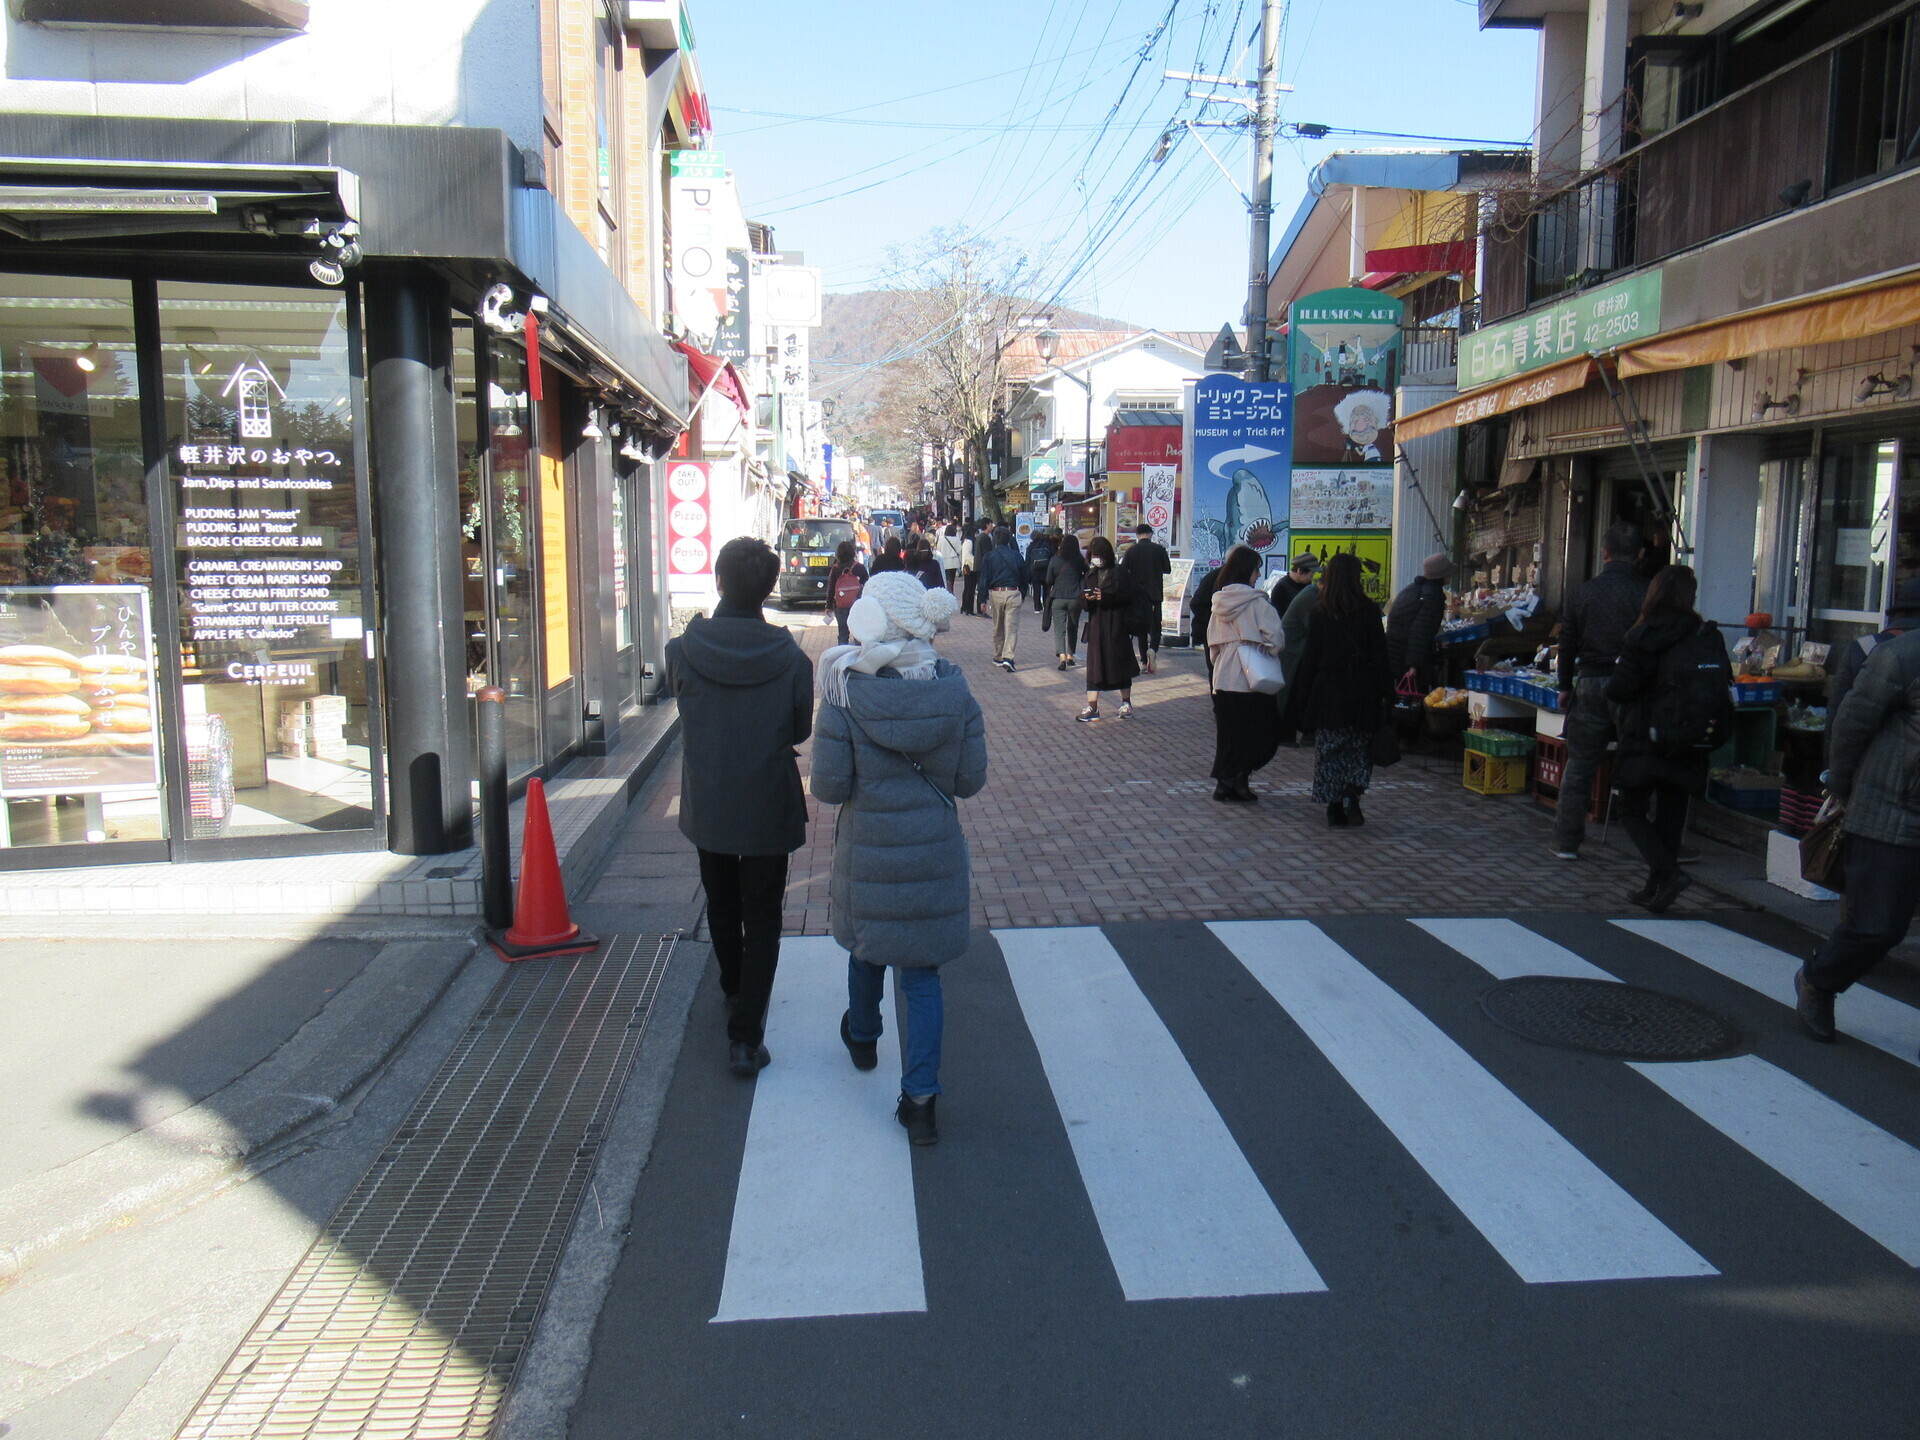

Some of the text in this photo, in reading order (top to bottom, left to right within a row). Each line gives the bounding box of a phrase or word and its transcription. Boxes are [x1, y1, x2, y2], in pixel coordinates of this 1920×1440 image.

[1299, 308, 1396, 320] ILLUSION ART
[1583, 311, 1639, 344] 42-2503
[721, 332, 740, 340] JAM
[1472, 310, 1577, 378] 白石青果店
[1209, 406, 1282, 420] ミュージアム
[1195, 427, 1285, 437] MUSEUM of Trick Art
[677, 470, 697, 478] TAKE
[237, 478, 260, 489] and
[261, 478, 333, 490] Sandcookies
[184, 508, 236, 519] PUDDING
[237, 508, 260, 519] JAM
[674, 510, 703, 521] Pizza
[186, 522, 237, 533] PUDDING
[238, 522, 260, 533] JAM
[187, 536, 322, 547] BASQUE CHEESE CAKE JAM
[674, 547, 704, 558] Pasta
[189, 561, 343, 571] CARAMEL CREAM RAISIN SAND
[190, 574, 331, 585] SWEET CREAM RAISIN SAND
[190, 588, 330, 599] CHEESE CREAM FRUIT SAND
[234, 602, 258, 612] SALT
[260, 601, 299, 612] BUTTER
[301, 601, 339, 611] COOKIE
[193, 615, 330, 627] STRAWBERRY MILLEFEUILLE
[194, 630, 227, 640] APPLE
[228, 629, 245, 640] PIE
[227, 662, 316, 679] CERFEUIL
